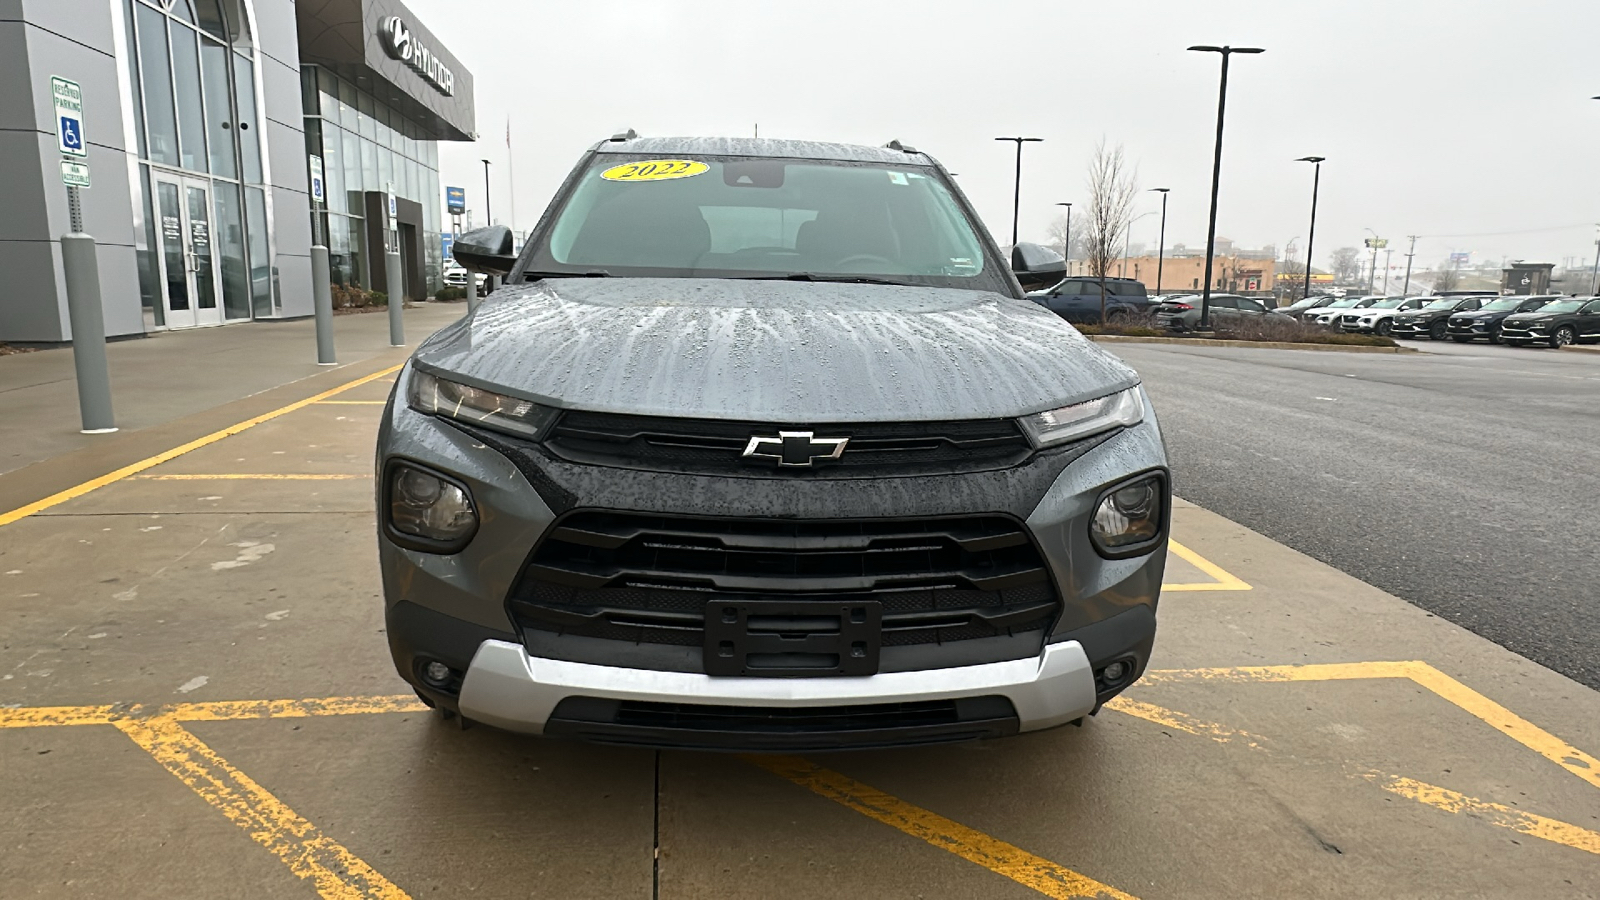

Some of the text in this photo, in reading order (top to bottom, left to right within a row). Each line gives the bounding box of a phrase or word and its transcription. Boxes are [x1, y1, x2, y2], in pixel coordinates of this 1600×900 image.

[413, 37, 454, 96] HYUNDAI
[54, 84, 79, 100] RESERVED
[55, 97, 81, 112] PARKING
[618, 162, 692, 179] 2022
